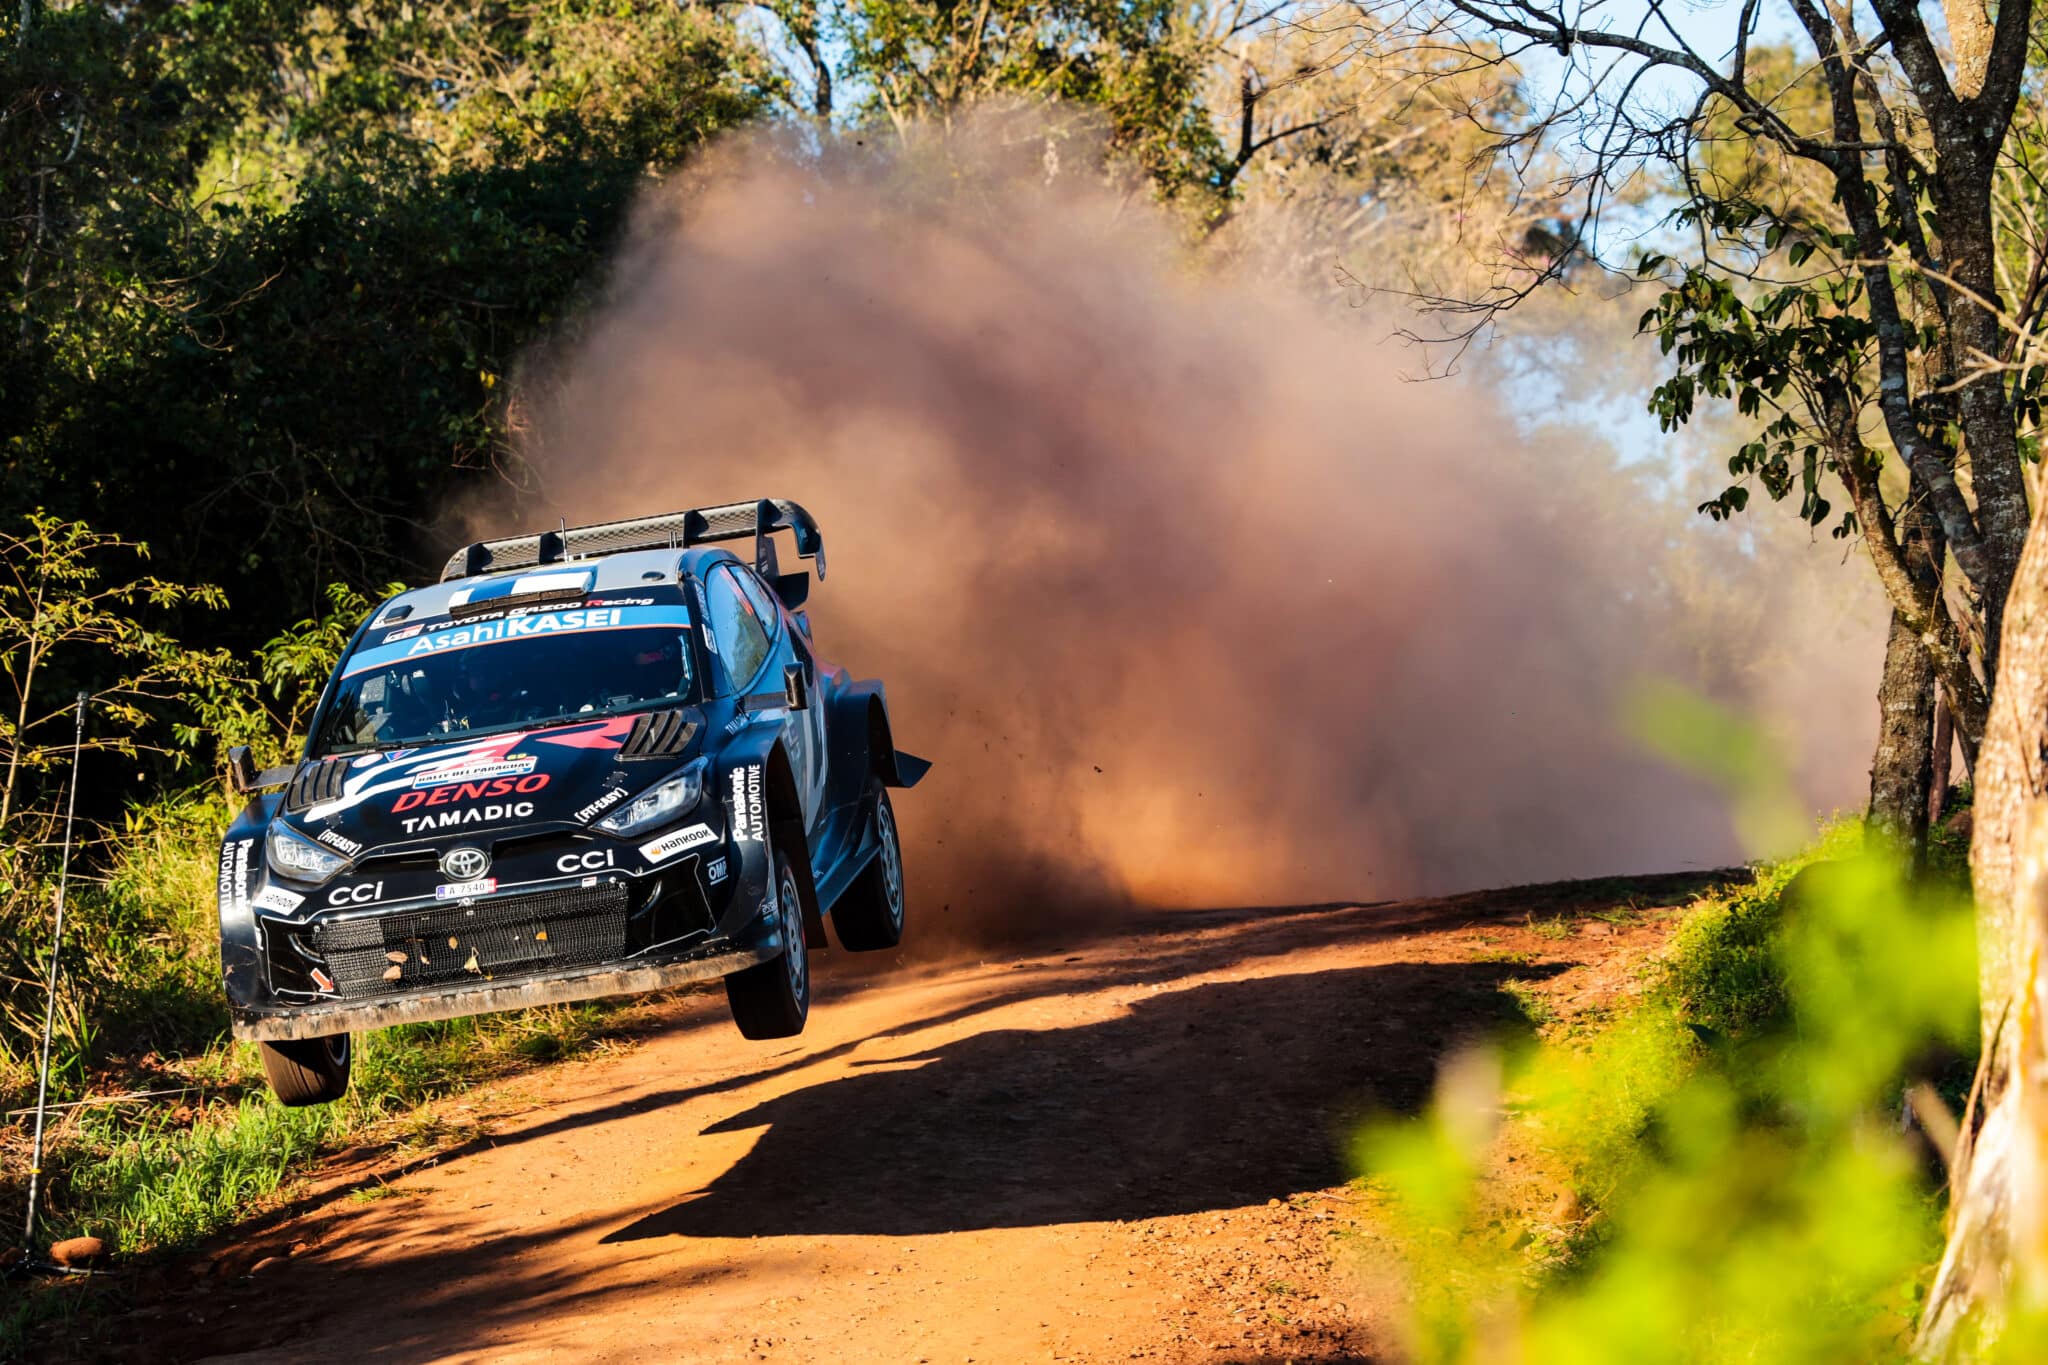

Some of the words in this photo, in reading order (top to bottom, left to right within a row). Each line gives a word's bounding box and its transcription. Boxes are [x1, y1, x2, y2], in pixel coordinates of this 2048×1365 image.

[427, 611, 504, 632] TOYOTA
[585, 598, 654, 608] Racing
[391, 773, 551, 813] DENSO
[729, 766, 749, 843] Panasonic
[748, 764, 764, 842] AUTOMOTIVE
[401, 802, 534, 834] TAMADIC
[556, 849, 614, 872] CCI
[708, 860, 728, 881] OMP
[328, 881, 384, 905] CCI
